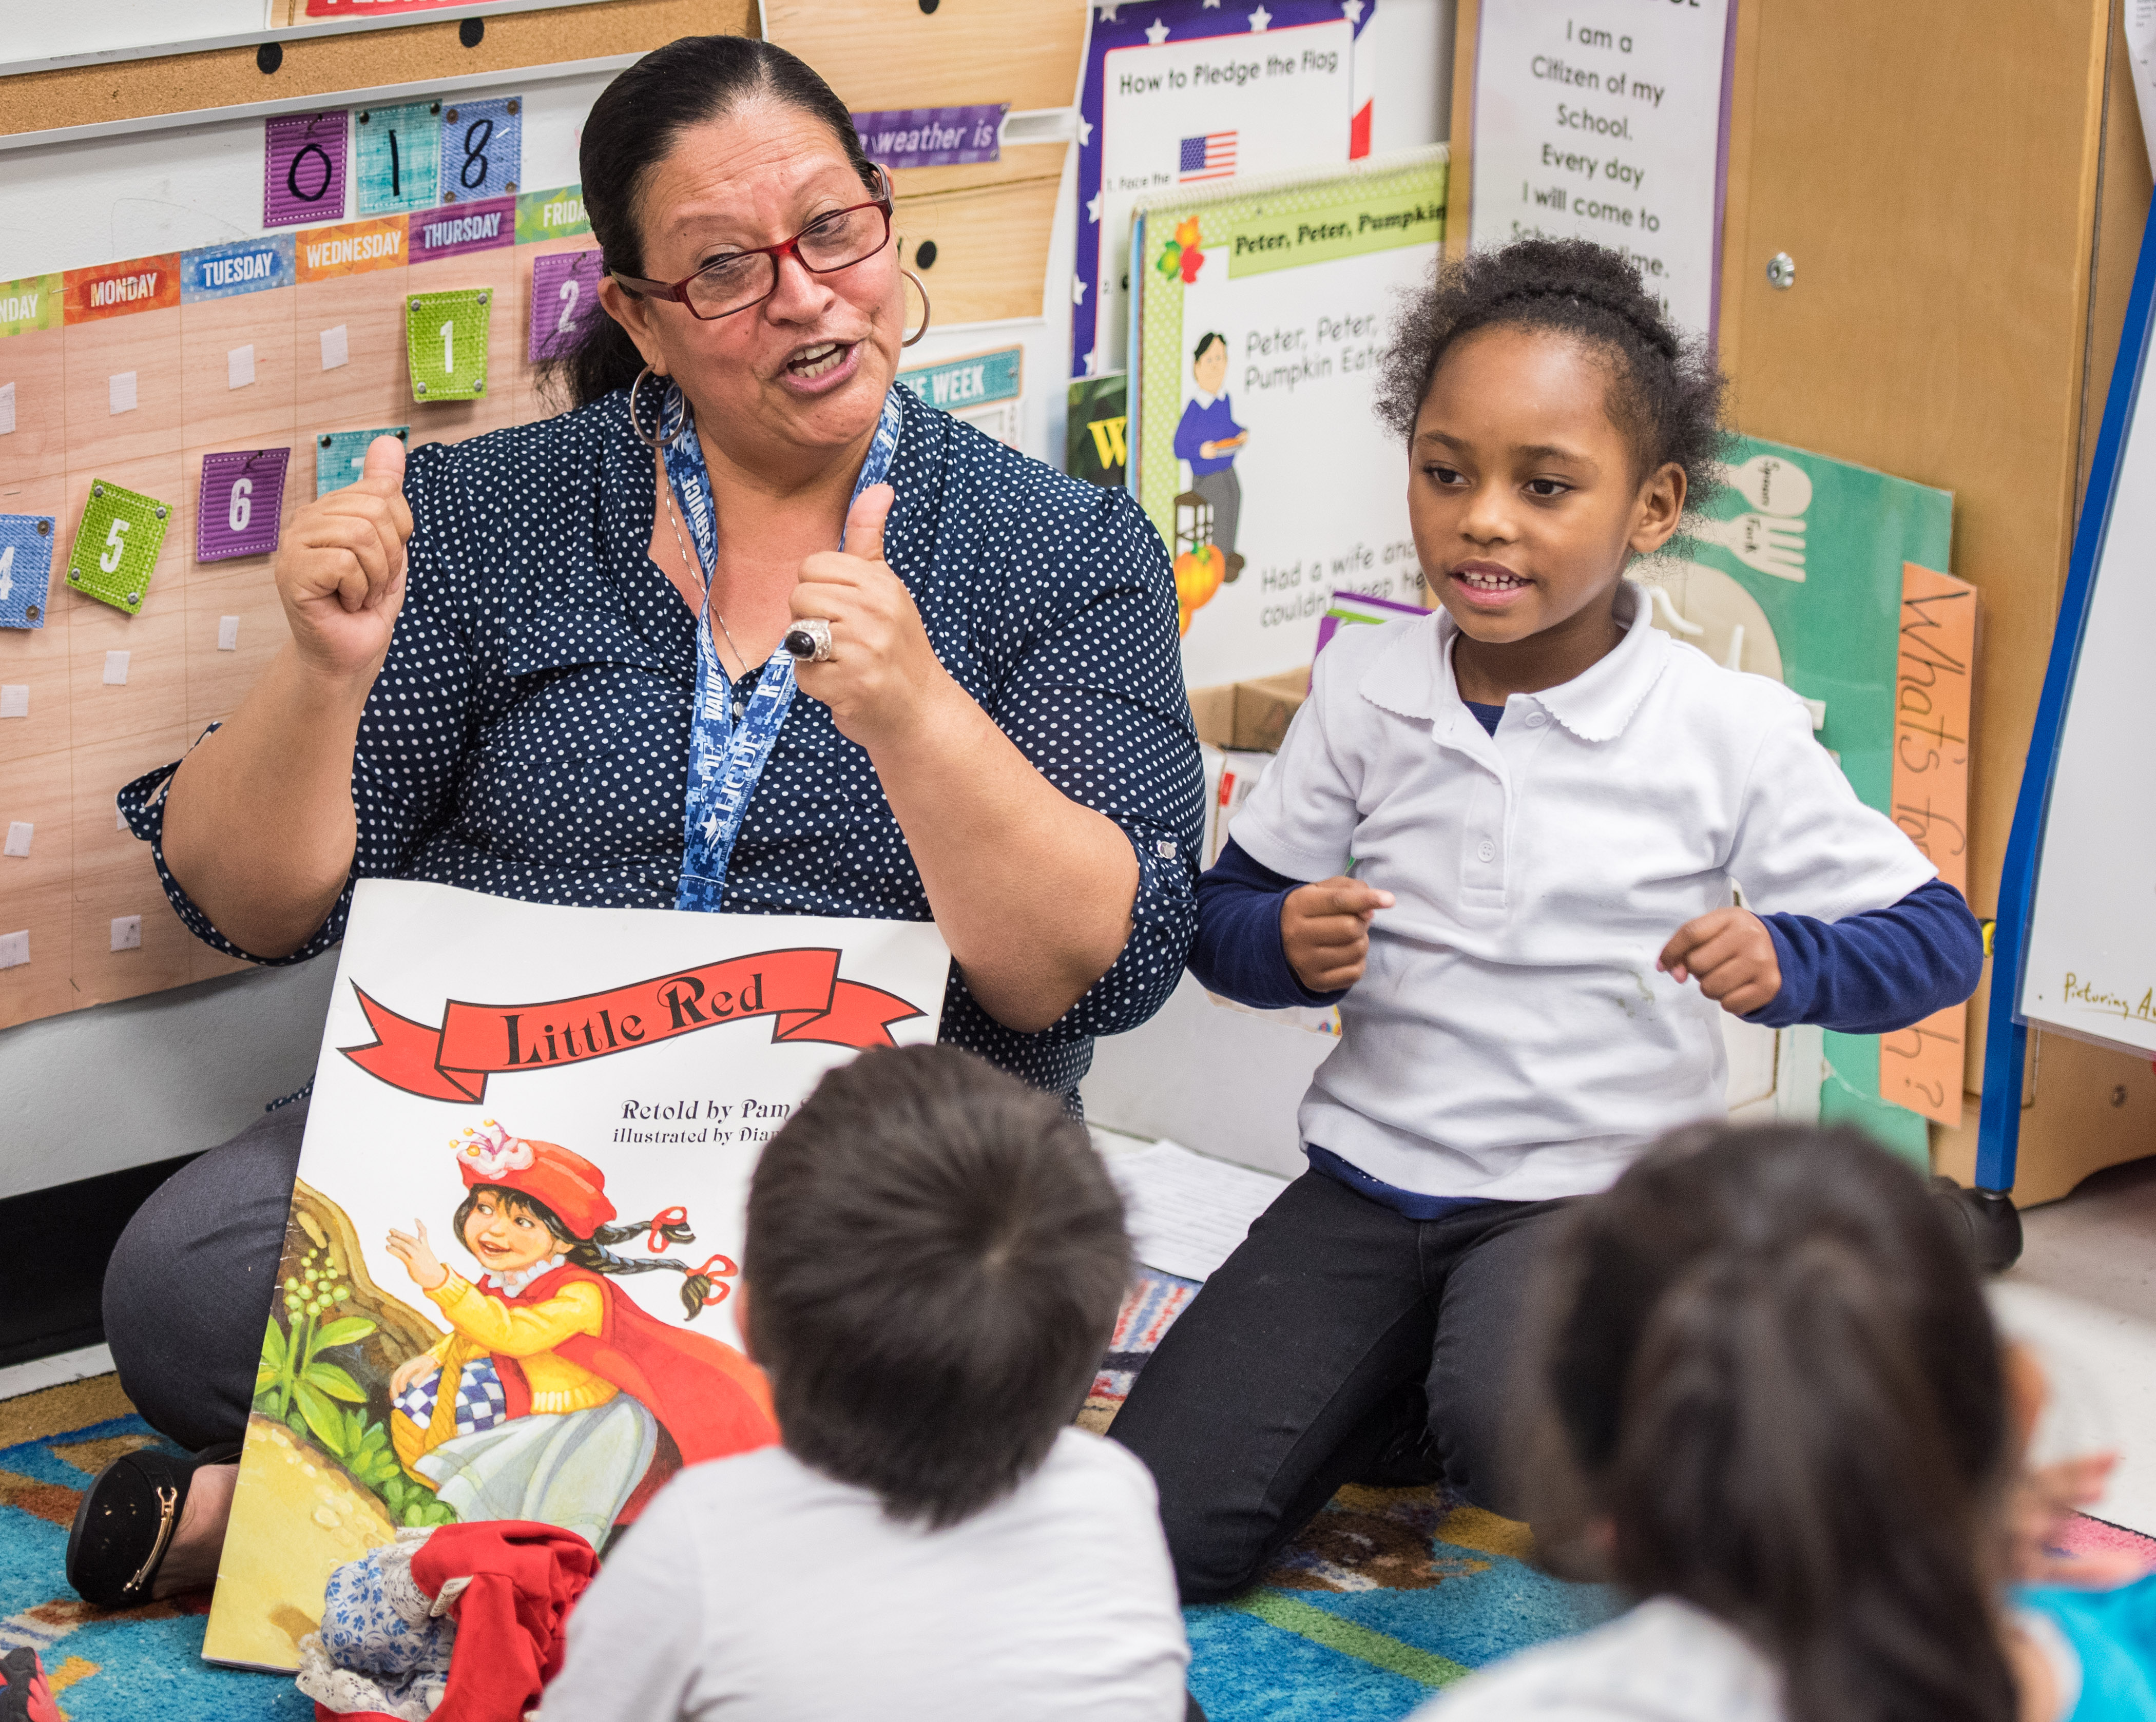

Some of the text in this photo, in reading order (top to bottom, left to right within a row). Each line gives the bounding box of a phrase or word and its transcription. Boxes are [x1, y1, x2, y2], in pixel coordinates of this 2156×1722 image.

[1566, 20, 1632, 53] I am a
[1120, 50, 1338, 95] How to Pledge the Flag
[1532, 55, 1665, 108] Citizen of my
[877, 121, 967, 153] weather
[973, 119, 993, 148] is
[1556, 103, 1633, 140] School.
[1152, 172, 1171, 185] the
[1542, 143, 1644, 190] Every day
[424, 212, 502, 249] THURSDAY
[543, 199, 586, 227] FRIDA
[1236, 203, 1447, 256] Peter, Peter, Pumpkin
[1523, 181, 1660, 233] I will come to
[203, 252, 274, 288] TUESDAY
[306, 229, 401, 269] WEDNESDAY
[90, 272, 158, 307] MONDAY
[558, 280, 580, 333] 2
[439, 320, 453, 373] 1
[1246, 314, 1378, 359] Peter, Peter,
[932, 365, 984, 404] WEEK
[1244, 342, 1388, 394] Pumpkin Eate
[228, 478, 252, 532] 6
[682, 475, 711, 550] SERVICE
[100, 518, 130, 574] 5
[1261, 559, 1301, 594] Had
[1310, 563, 1322, 582] a
[1331, 541, 1374, 576] wife
[1402, 566, 1428, 591] he
[704, 669, 724, 721] VALUE
[1900, 591, 1971, 773] What's
[714, 730, 765, 812] HCDE
[2064, 972, 2129, 1020] Picturing
[500, 973, 767, 1067] Little Red
[621, 1099, 699, 1120] Retold
[706, 1100, 734, 1124] by
[740, 1099, 791, 1122] Pam
[612, 1128, 708, 1144] illustrated
[713, 1128, 734, 1146] by
